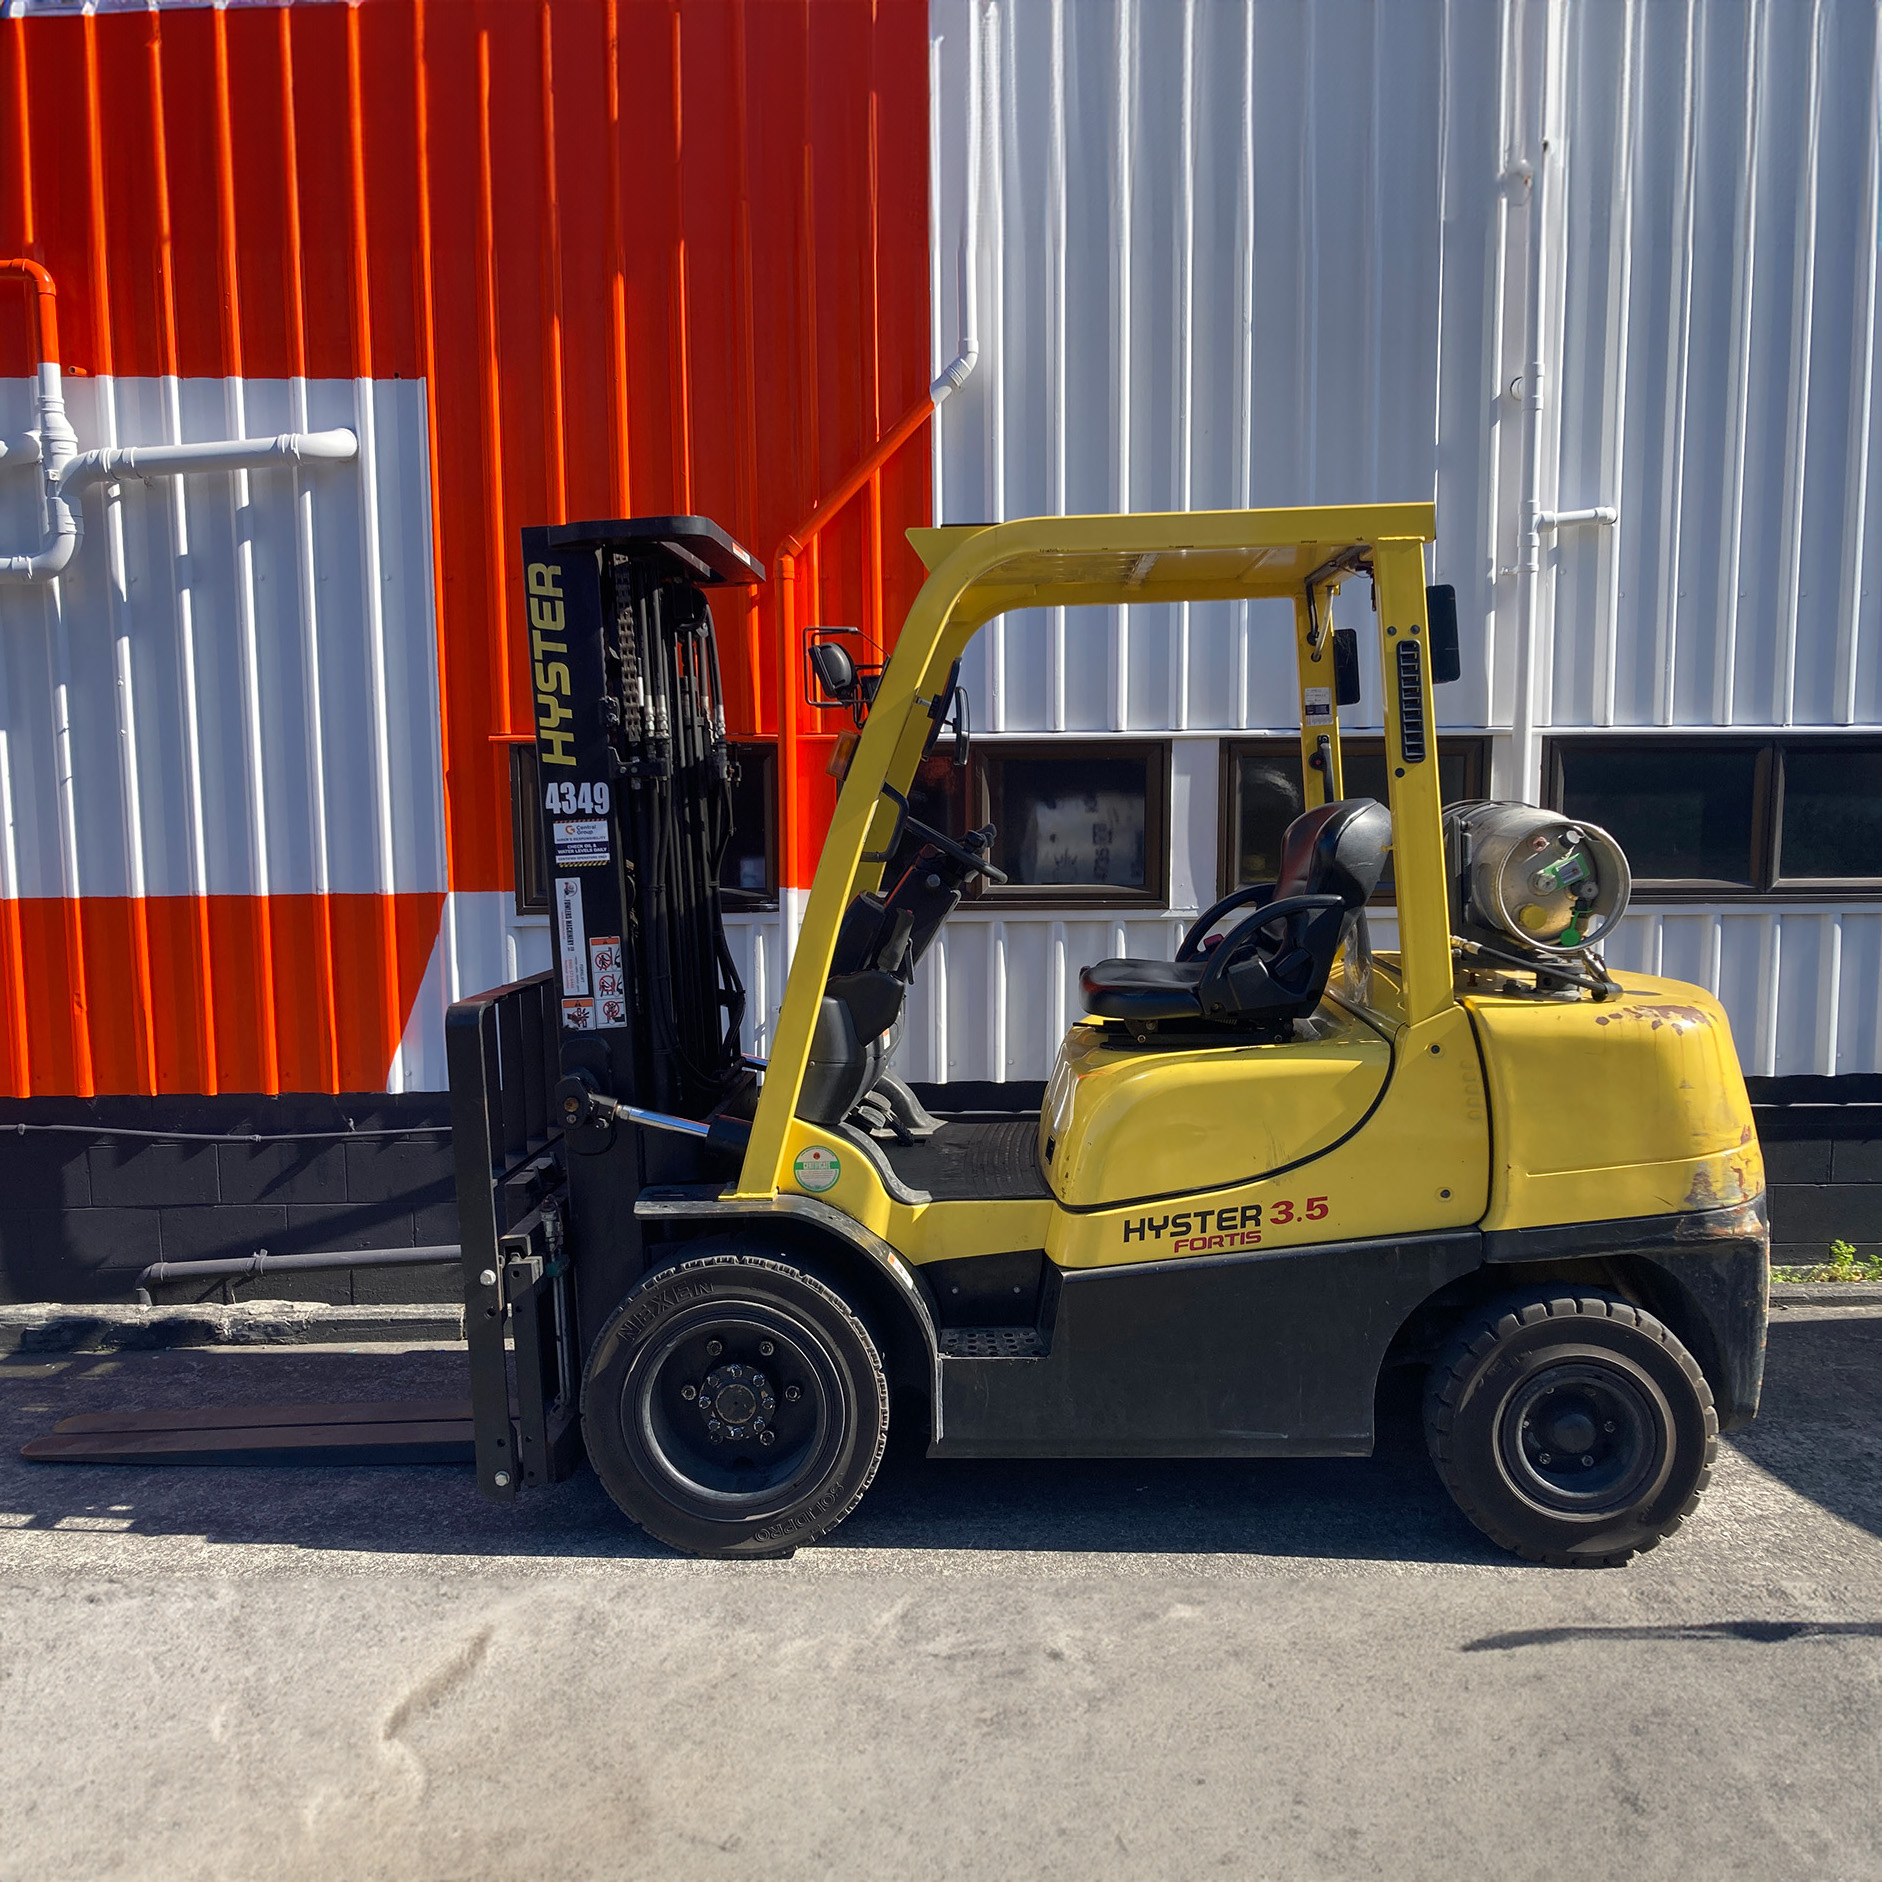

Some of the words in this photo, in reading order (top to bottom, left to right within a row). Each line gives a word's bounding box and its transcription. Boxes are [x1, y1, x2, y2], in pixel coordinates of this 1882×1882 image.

[527, 562, 577, 766] HYSTER
[545, 781, 610, 815] 4349
[564, 899, 572, 919] FOWLERS
[565, 920, 574, 946] MACHINERY
[1123, 1204, 1263, 1243] HYSTER
[1269, 1195, 1329, 1225] 3.5
[1174, 1230, 1262, 1253] FORTIS
[617, 1277, 715, 1342] NEXEN
